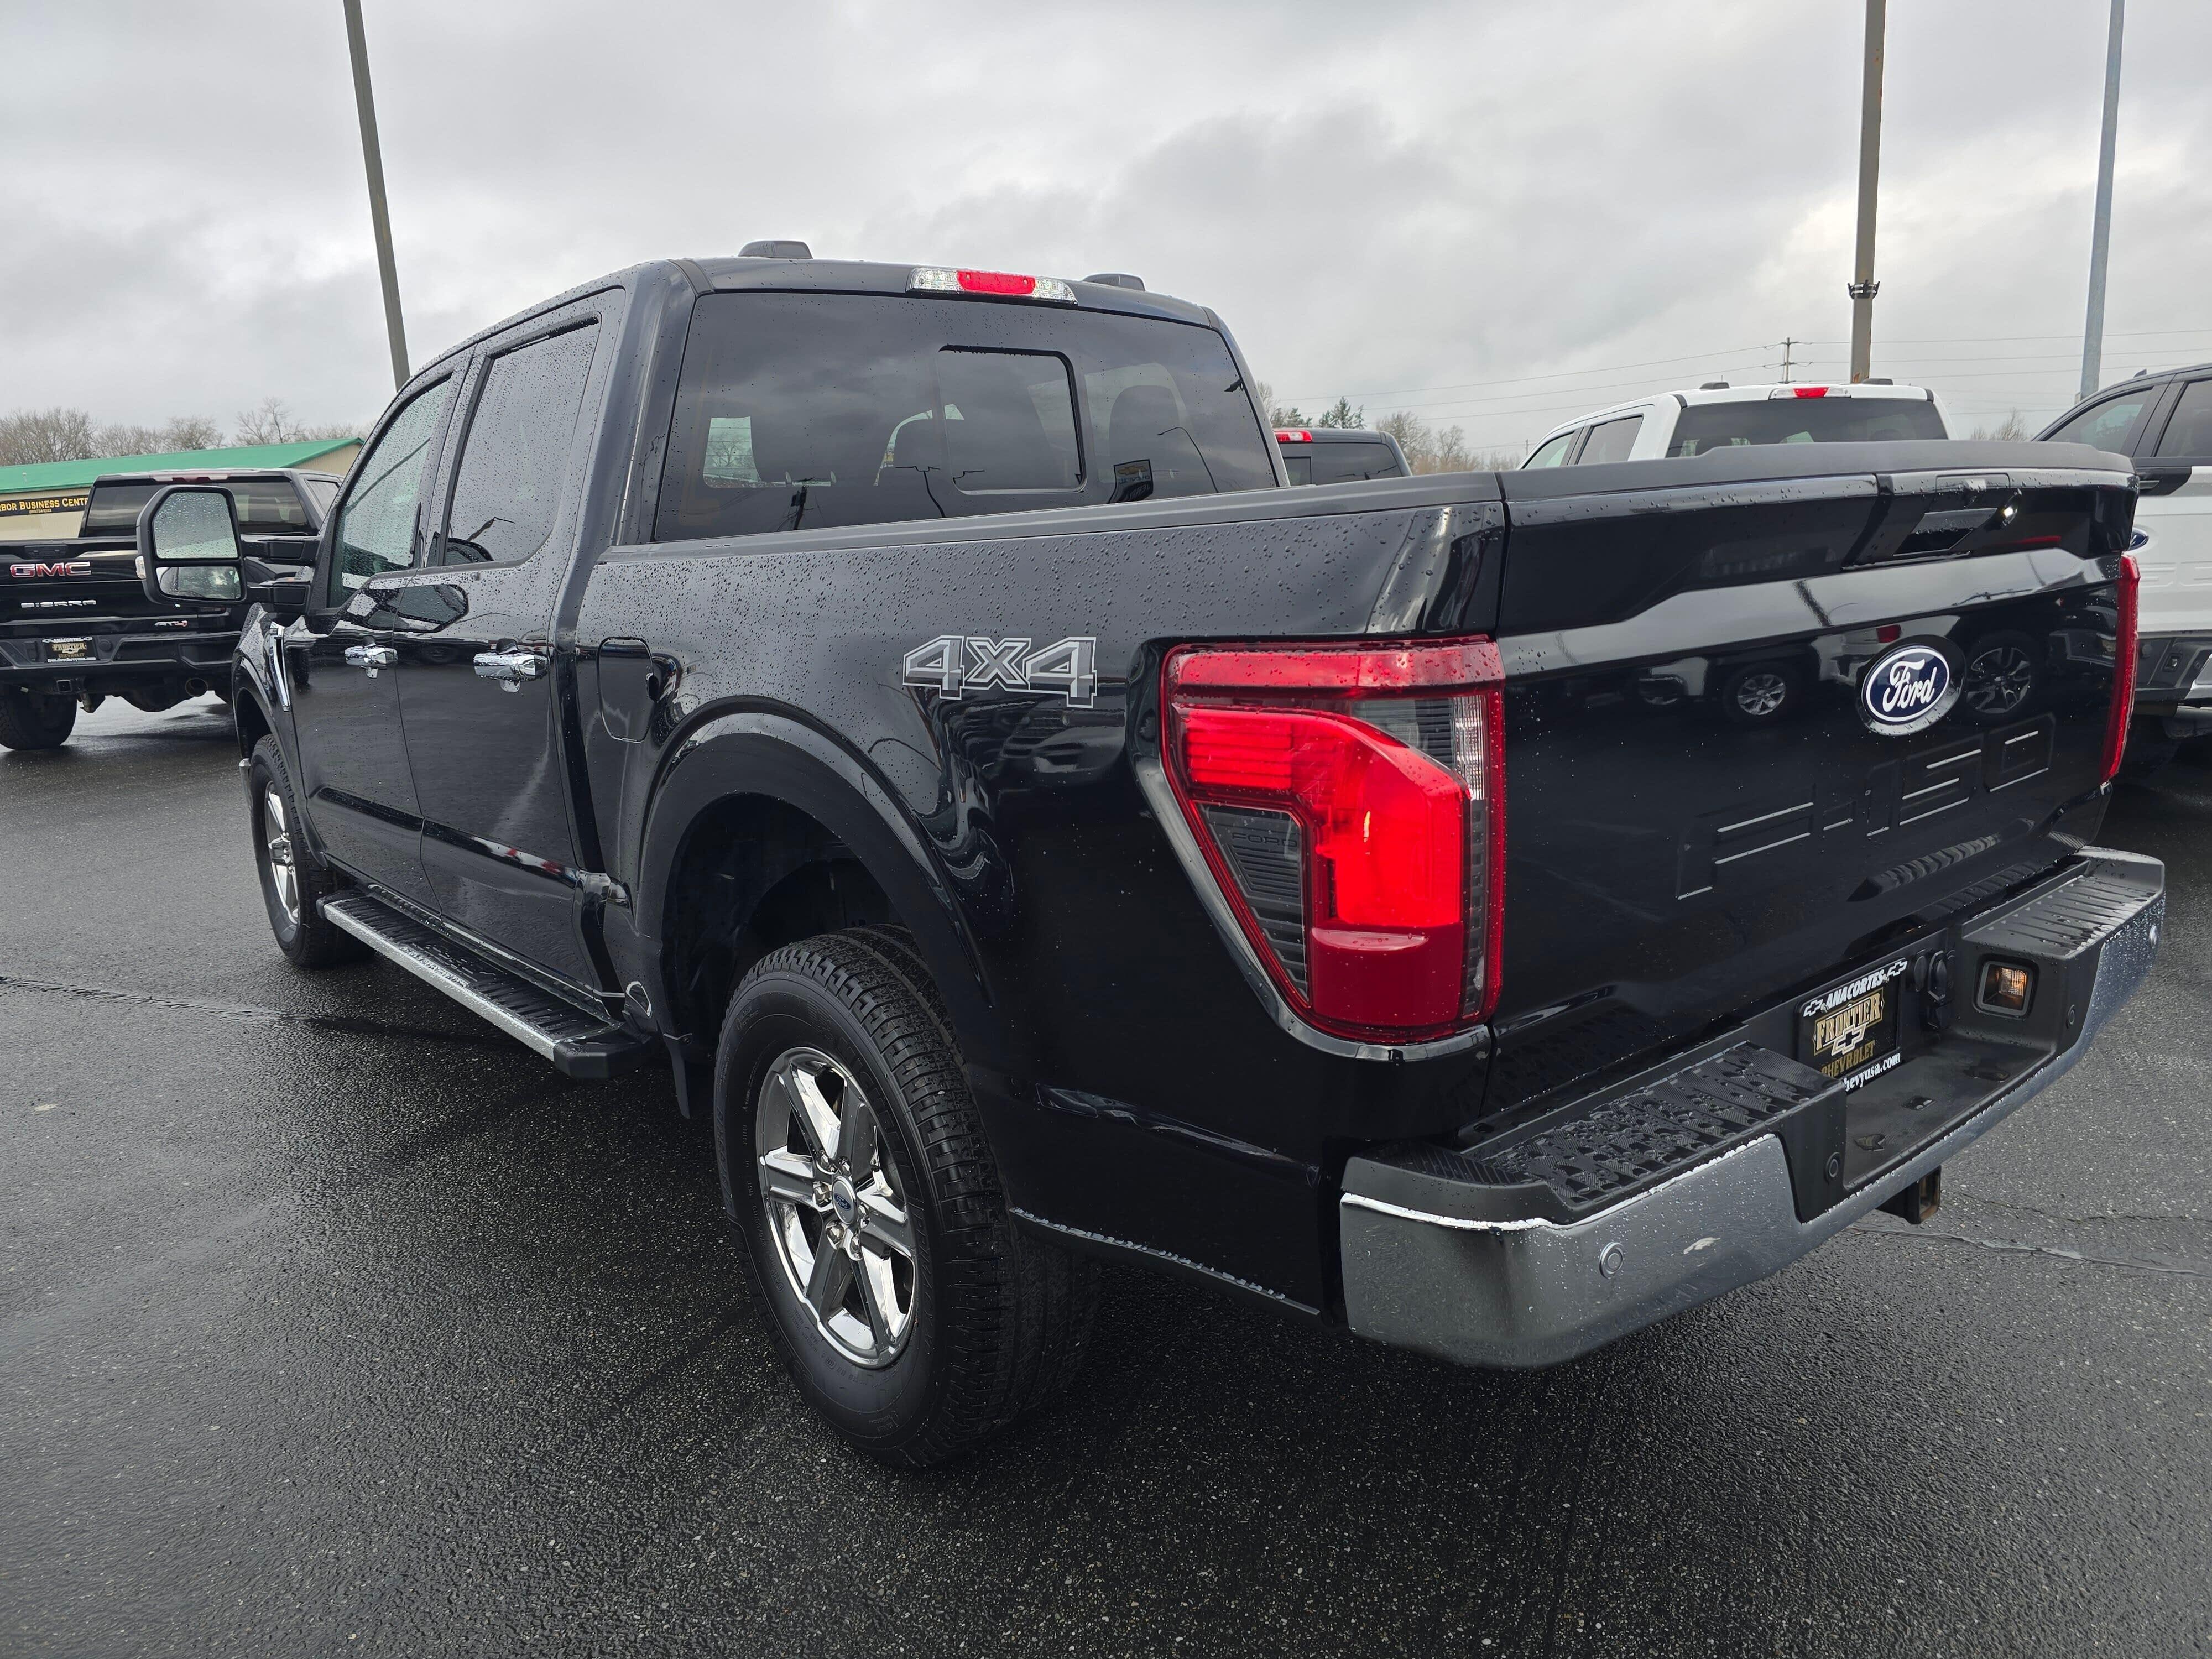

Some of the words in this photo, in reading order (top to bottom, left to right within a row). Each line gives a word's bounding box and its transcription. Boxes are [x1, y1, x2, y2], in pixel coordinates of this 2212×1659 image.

[0, 503, 17, 512] BOR
[19, 500, 60, 510] BUSINESS
[10, 561, 92, 578] GMC
[1882, 659, 1938, 712] Ford
[1232, 832, 1297, 847] FORD
[1825, 969, 1885, 1010] ANACORTES
[1816, 993, 1881, 1051] FRONTIER
[1843, 1052, 1901, 1092] hevyusa.com
